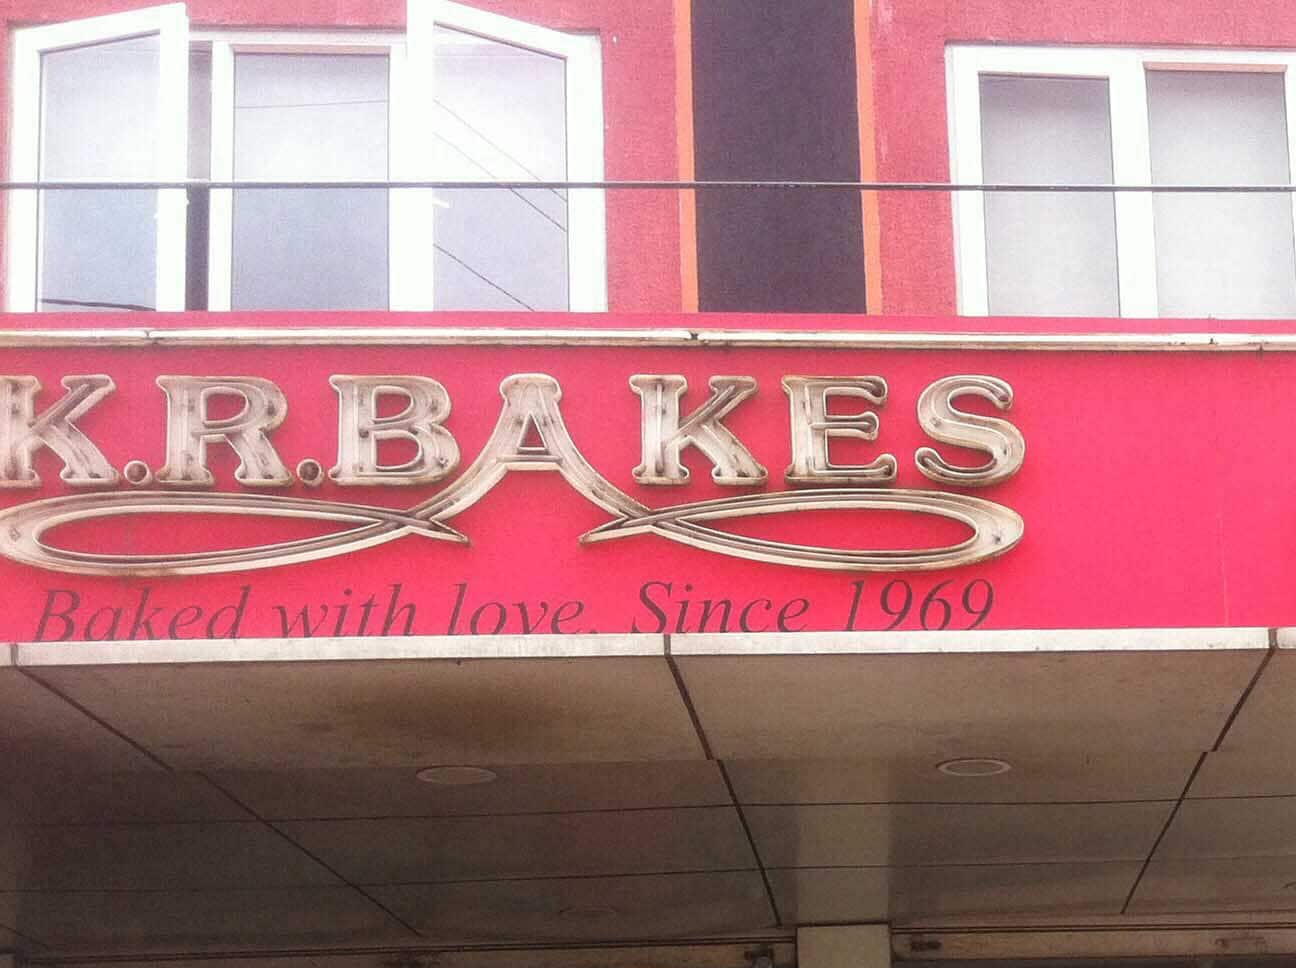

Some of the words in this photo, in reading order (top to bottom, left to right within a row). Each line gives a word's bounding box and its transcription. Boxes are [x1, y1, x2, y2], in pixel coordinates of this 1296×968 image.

[34, 585, 252, 642] Baked
[270, 582, 415, 638] with
[446, 582, 598, 637] love.
[631, 580, 810, 634] Since
[846, 578, 995, 632] 1969
